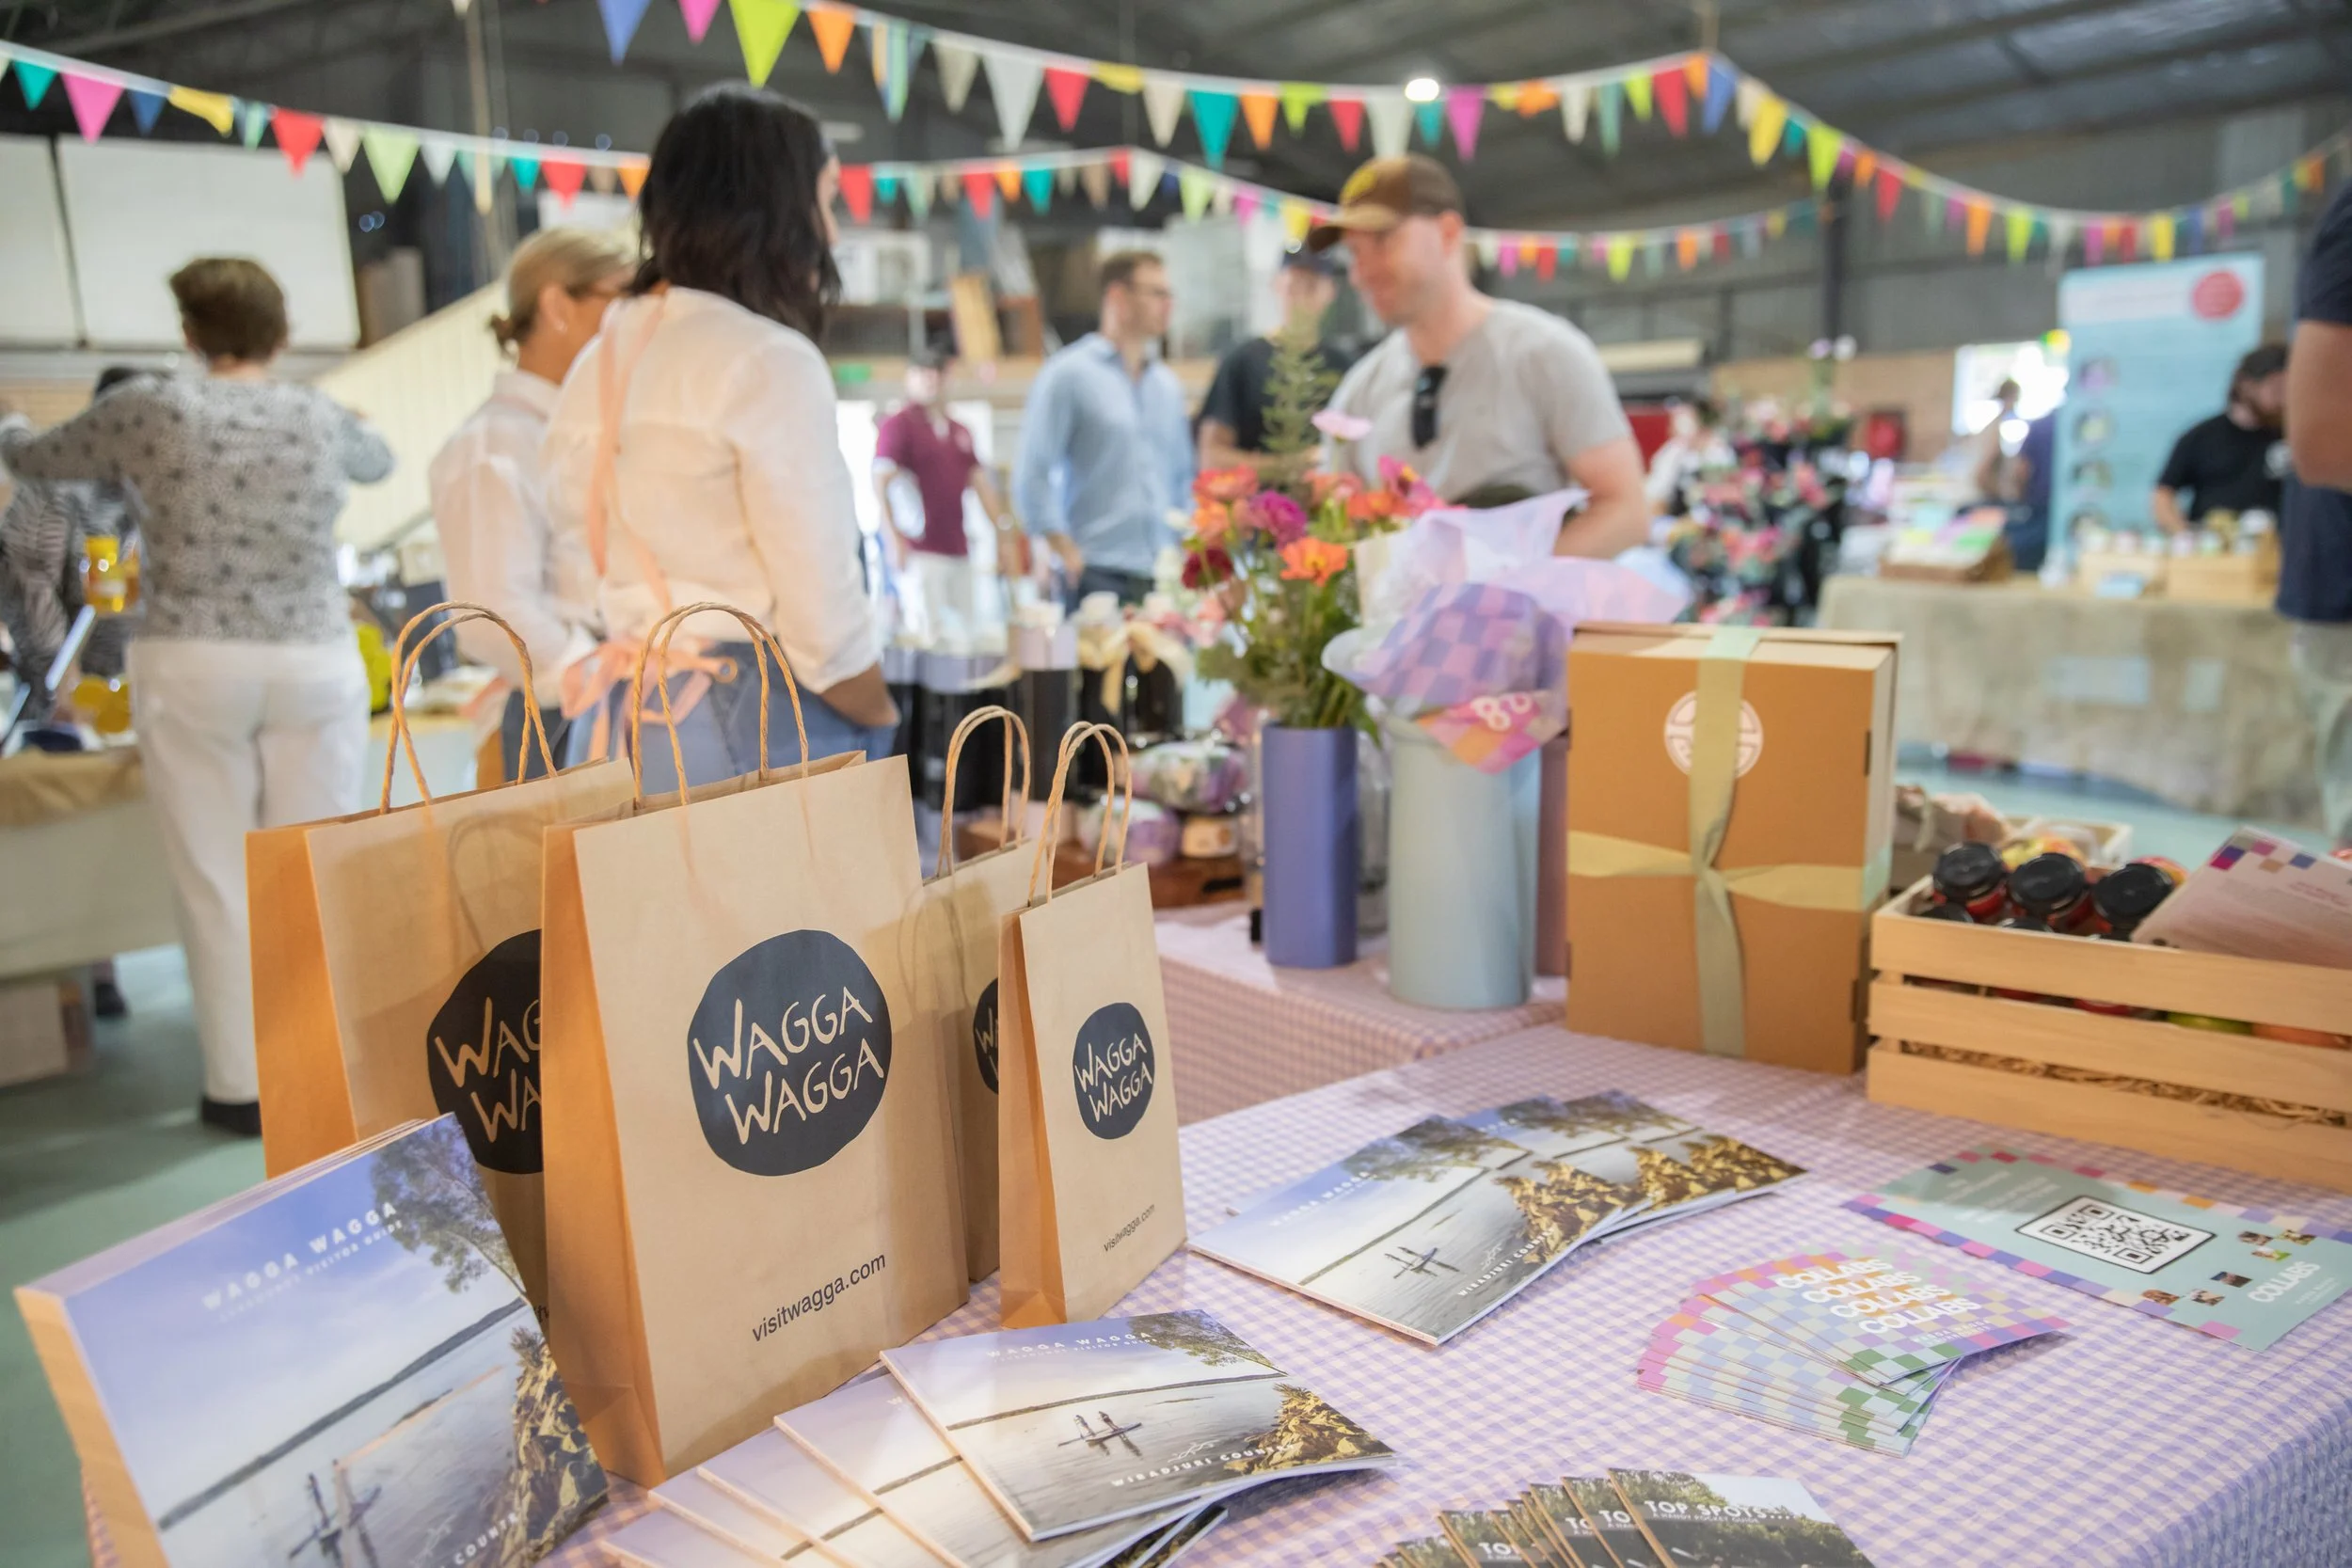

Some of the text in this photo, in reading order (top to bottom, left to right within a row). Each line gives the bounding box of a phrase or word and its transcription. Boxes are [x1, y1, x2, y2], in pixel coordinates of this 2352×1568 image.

[435, 997, 541, 1087] WAG
[692, 986, 873, 1089] WAGGA
[1074, 1033, 1147, 1093] WAGGA
[724, 1037, 884, 1145] WAGGA
[1089, 1062, 1152, 1122] WAGGA
[309, 1202, 397, 1254] WAGGA
[1775, 1259, 1893, 1289] COLLABS
[1801, 1271, 1922, 1303] COLLABS
[2247, 1260, 2321, 1303] COLLABS
[753, 1254, 886, 1342] visitwagga.com
[1830, 1284, 1952, 1318] COLLABS
[1858, 1297, 1982, 1334] COLLABS
[985, 1332, 1152, 1357] WAGGA WAGGA
[1111, 1457, 1213, 1486] WIRADJURI
[1598, 1510, 1631, 1523] TO
[1645, 1500, 1689, 1513] TOP
[454, 1512, 519, 1565] COUNTR
[1478, 1542, 1512, 1556] TO
